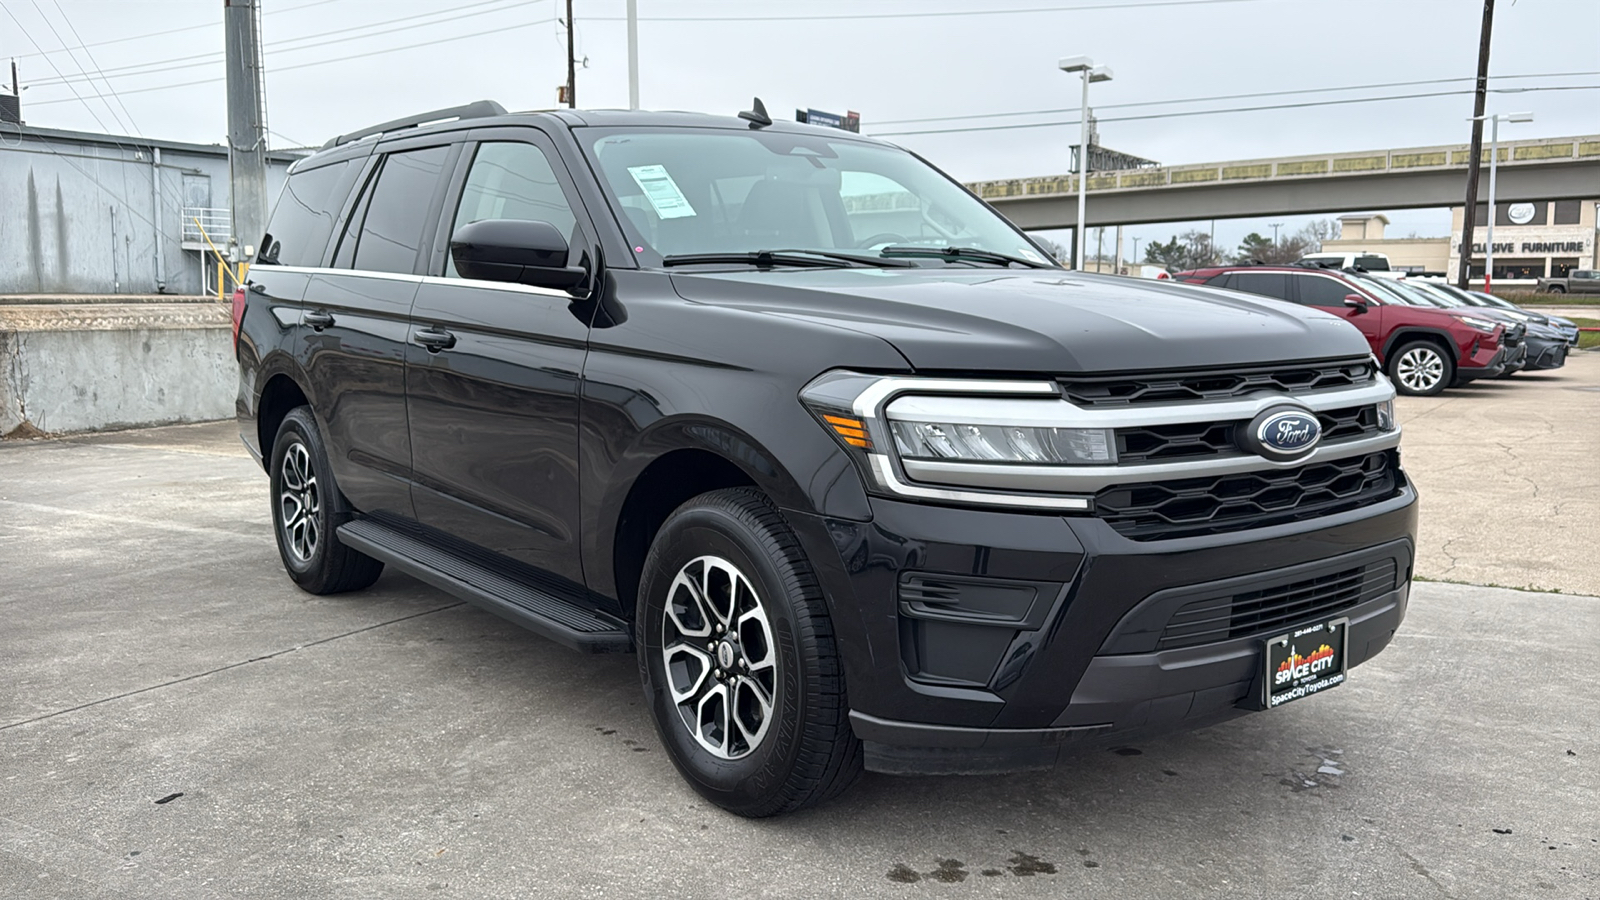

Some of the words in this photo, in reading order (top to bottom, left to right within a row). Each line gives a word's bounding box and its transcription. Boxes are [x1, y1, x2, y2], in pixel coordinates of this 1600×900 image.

[1521, 241, 1583, 253] FURNITURE
[1277, 420, 1310, 444] Ford
[1275, 664, 1309, 685] SPACE
[1311, 655, 1334, 672] CITY
[1300, 674, 1317, 684] TOYOTA
[1271, 674, 1344, 705] SpaceCityToyota.com
